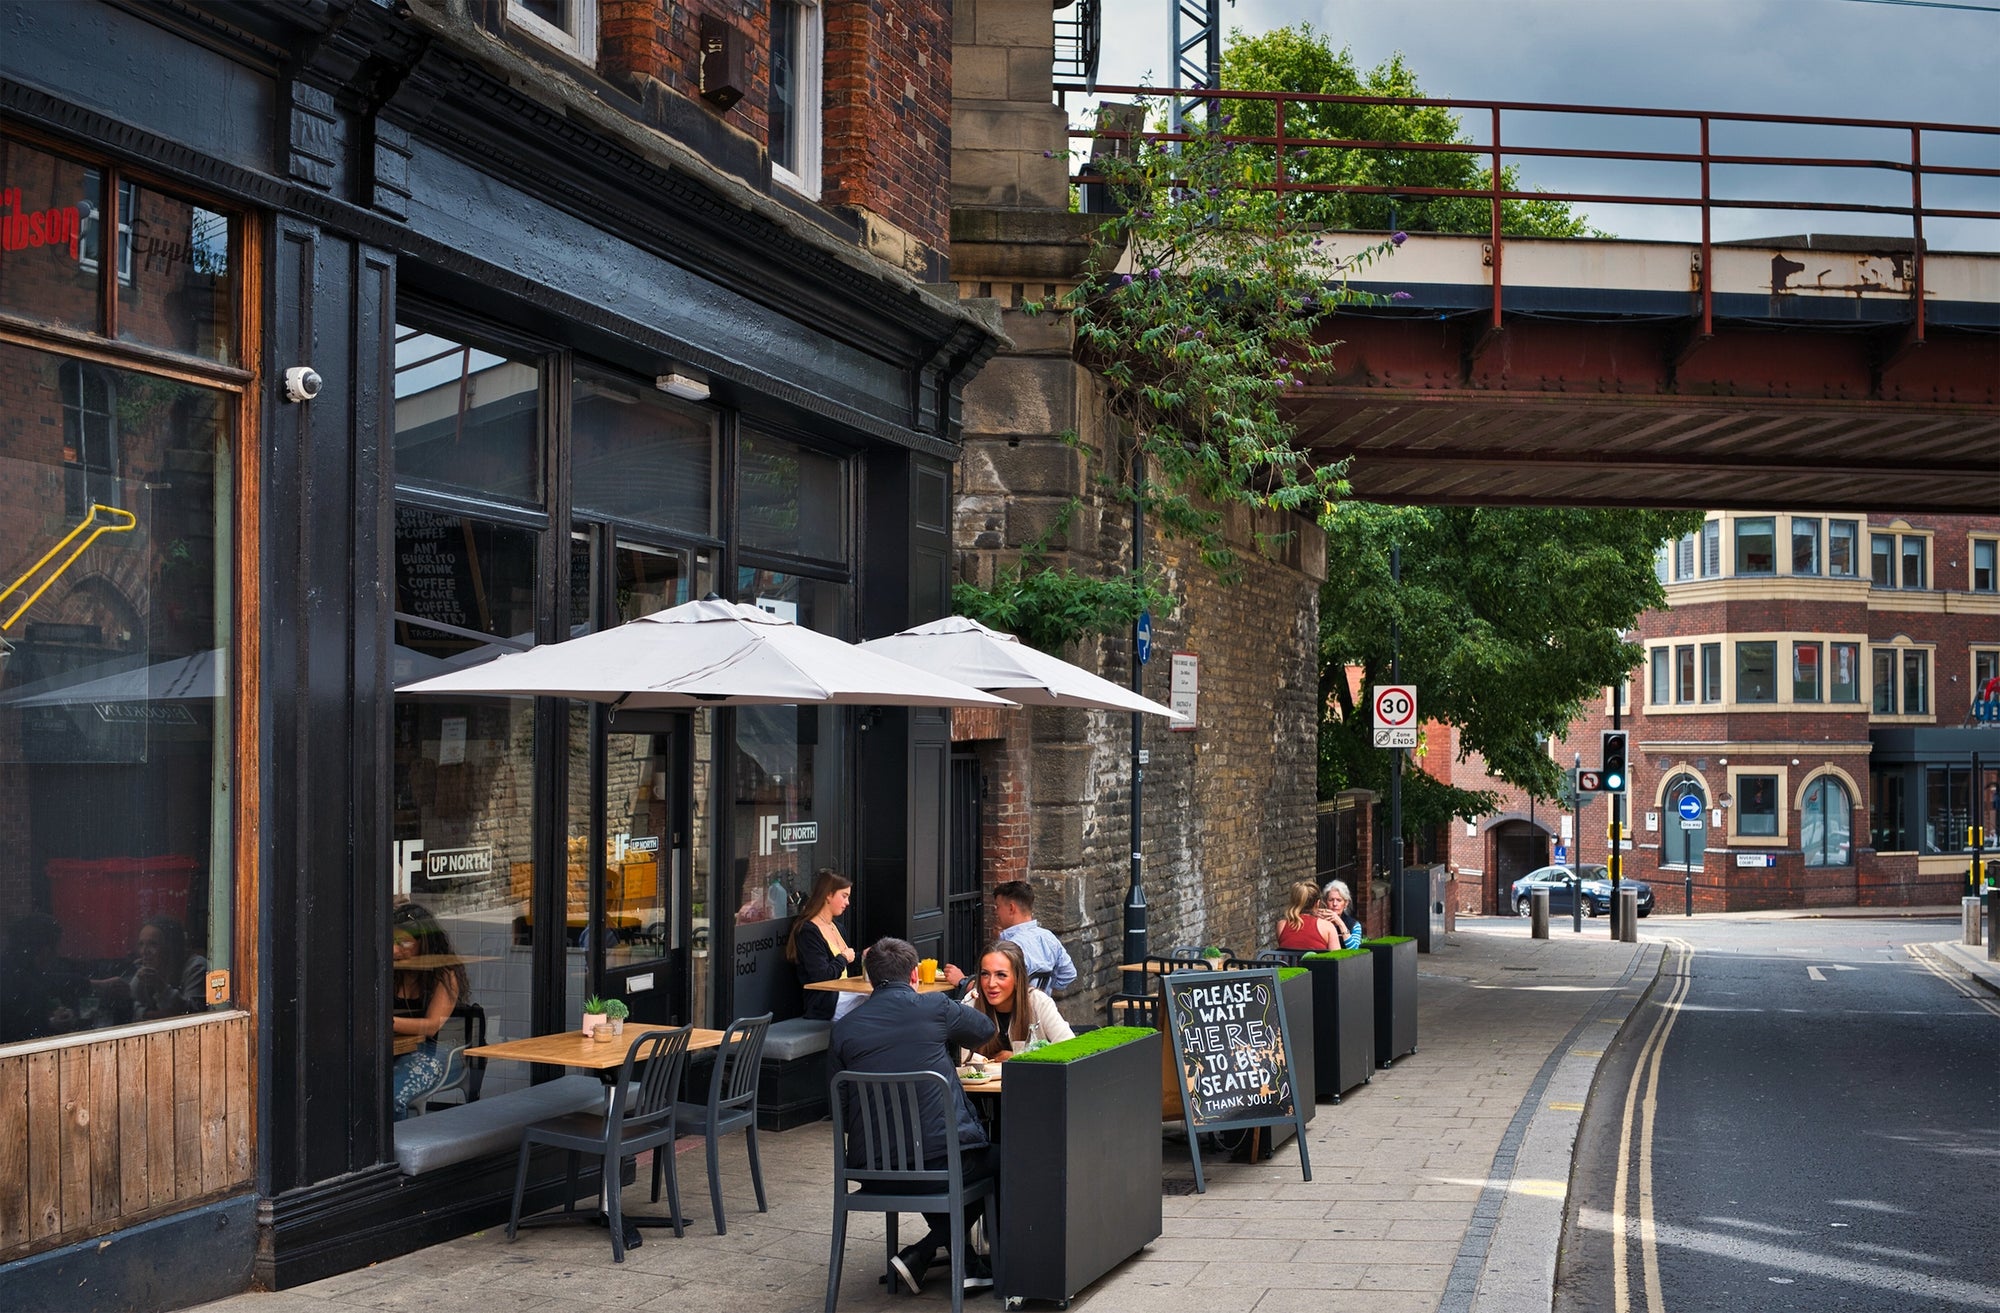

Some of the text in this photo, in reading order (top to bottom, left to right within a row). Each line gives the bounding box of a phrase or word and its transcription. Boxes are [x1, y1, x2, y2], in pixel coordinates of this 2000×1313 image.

[0, 186, 80, 261] ibson
[413, 542, 438, 555] ANY
[401, 553, 456, 565] BURRITO
[408, 577, 456, 590] COFFEE
[414, 600, 462, 612] COFFEE
[1382, 699, 1409, 714] 30
[759, 815, 779, 856] IF
[782, 826, 815, 840] UP NORTH
[615, 833, 630, 861] IF
[640, 840, 657, 849] NORTH
[393, 839, 424, 896] IF
[431, 852, 488, 873] UP NORTH
[736, 937, 774, 958] espresso
[736, 957, 756, 976] food
[1193, 982, 1253, 1008] PLEASE
[1199, 1003, 1246, 1023] WAIT
[1184, 1020, 1267, 1053] HERE
[1205, 1049, 1261, 1074] TO BE
[1201, 1070, 1271, 1097] SEATED
[1205, 1095, 1244, 1112] THANK
